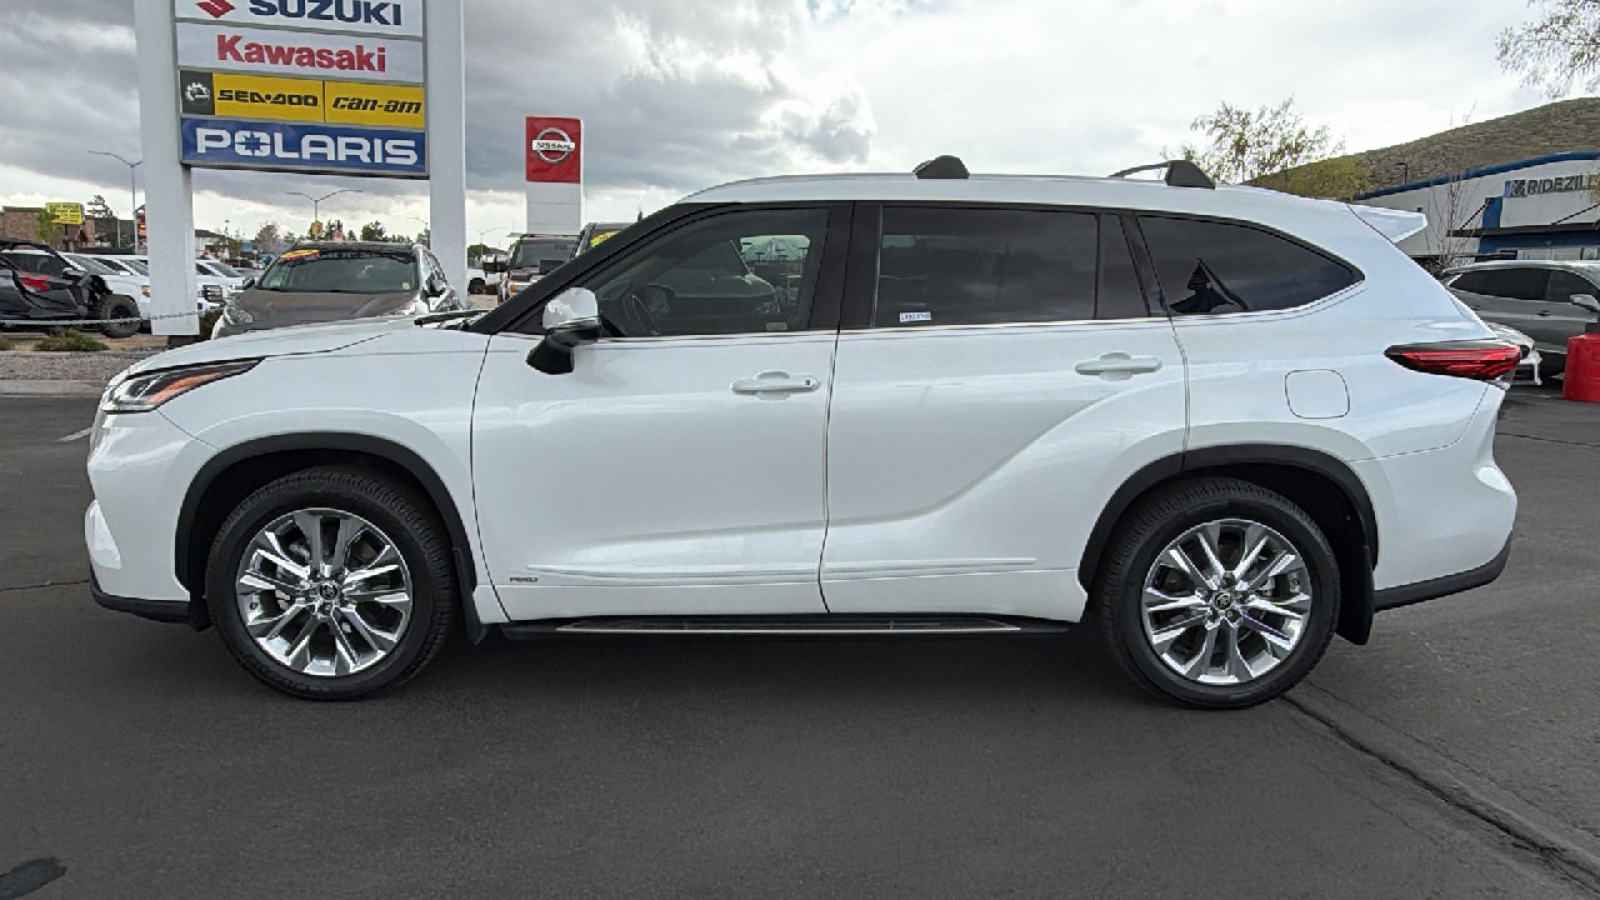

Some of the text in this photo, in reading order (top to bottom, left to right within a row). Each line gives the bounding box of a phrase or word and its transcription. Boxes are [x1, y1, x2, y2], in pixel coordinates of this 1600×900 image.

[249, 0, 402, 26] SUZUKI
[217, 34, 386, 73] Kawasaki
[195, 127, 418, 166] POLARIS
[536, 141, 572, 151] NISSAN
